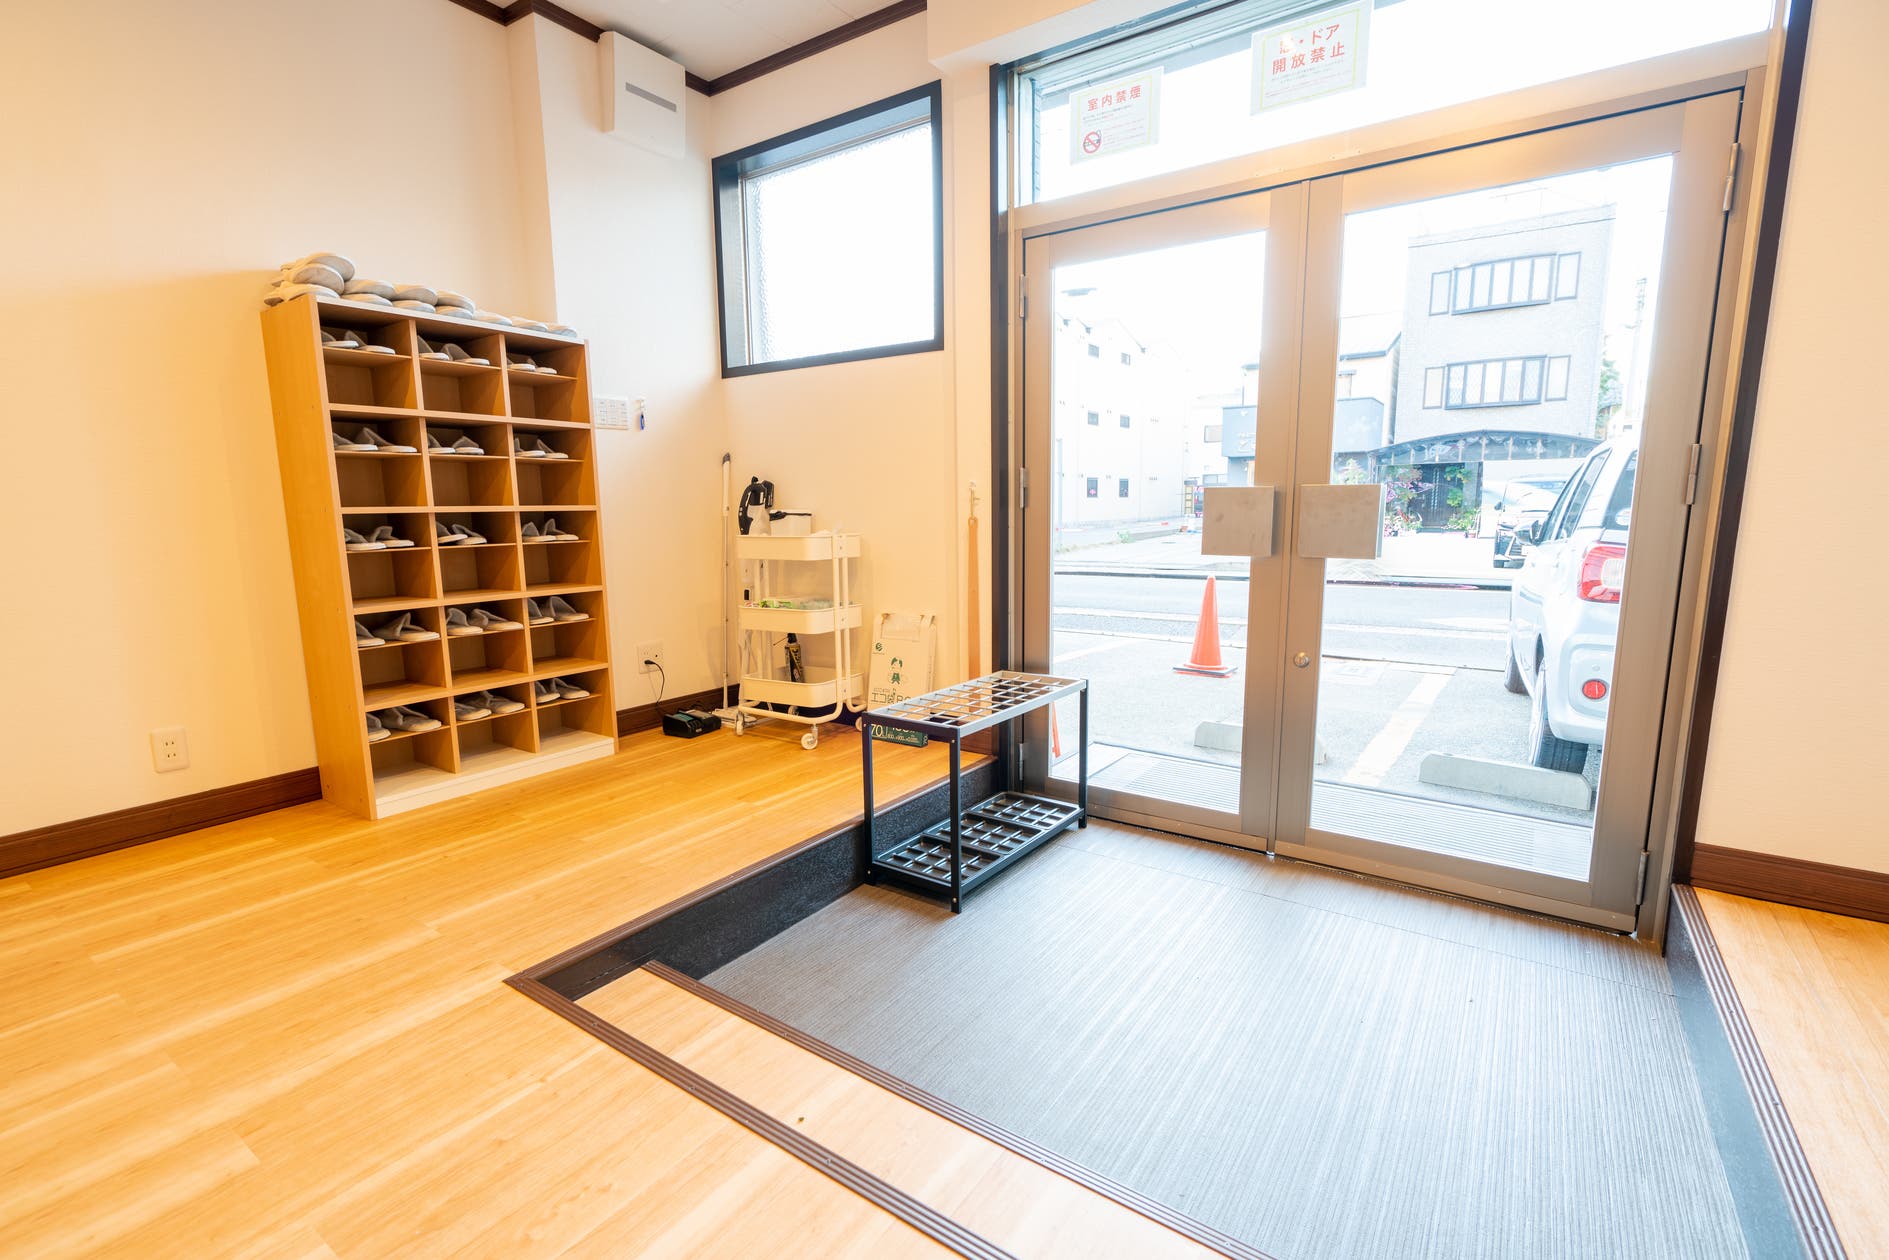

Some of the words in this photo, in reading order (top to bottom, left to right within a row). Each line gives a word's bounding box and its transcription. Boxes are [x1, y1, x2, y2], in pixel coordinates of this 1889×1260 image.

[1279, 24, 1340, 54] ・ドア
[1272, 41, 1345, 75] 開放禁止
[1087, 85, 1142, 112] 室内禁煙
